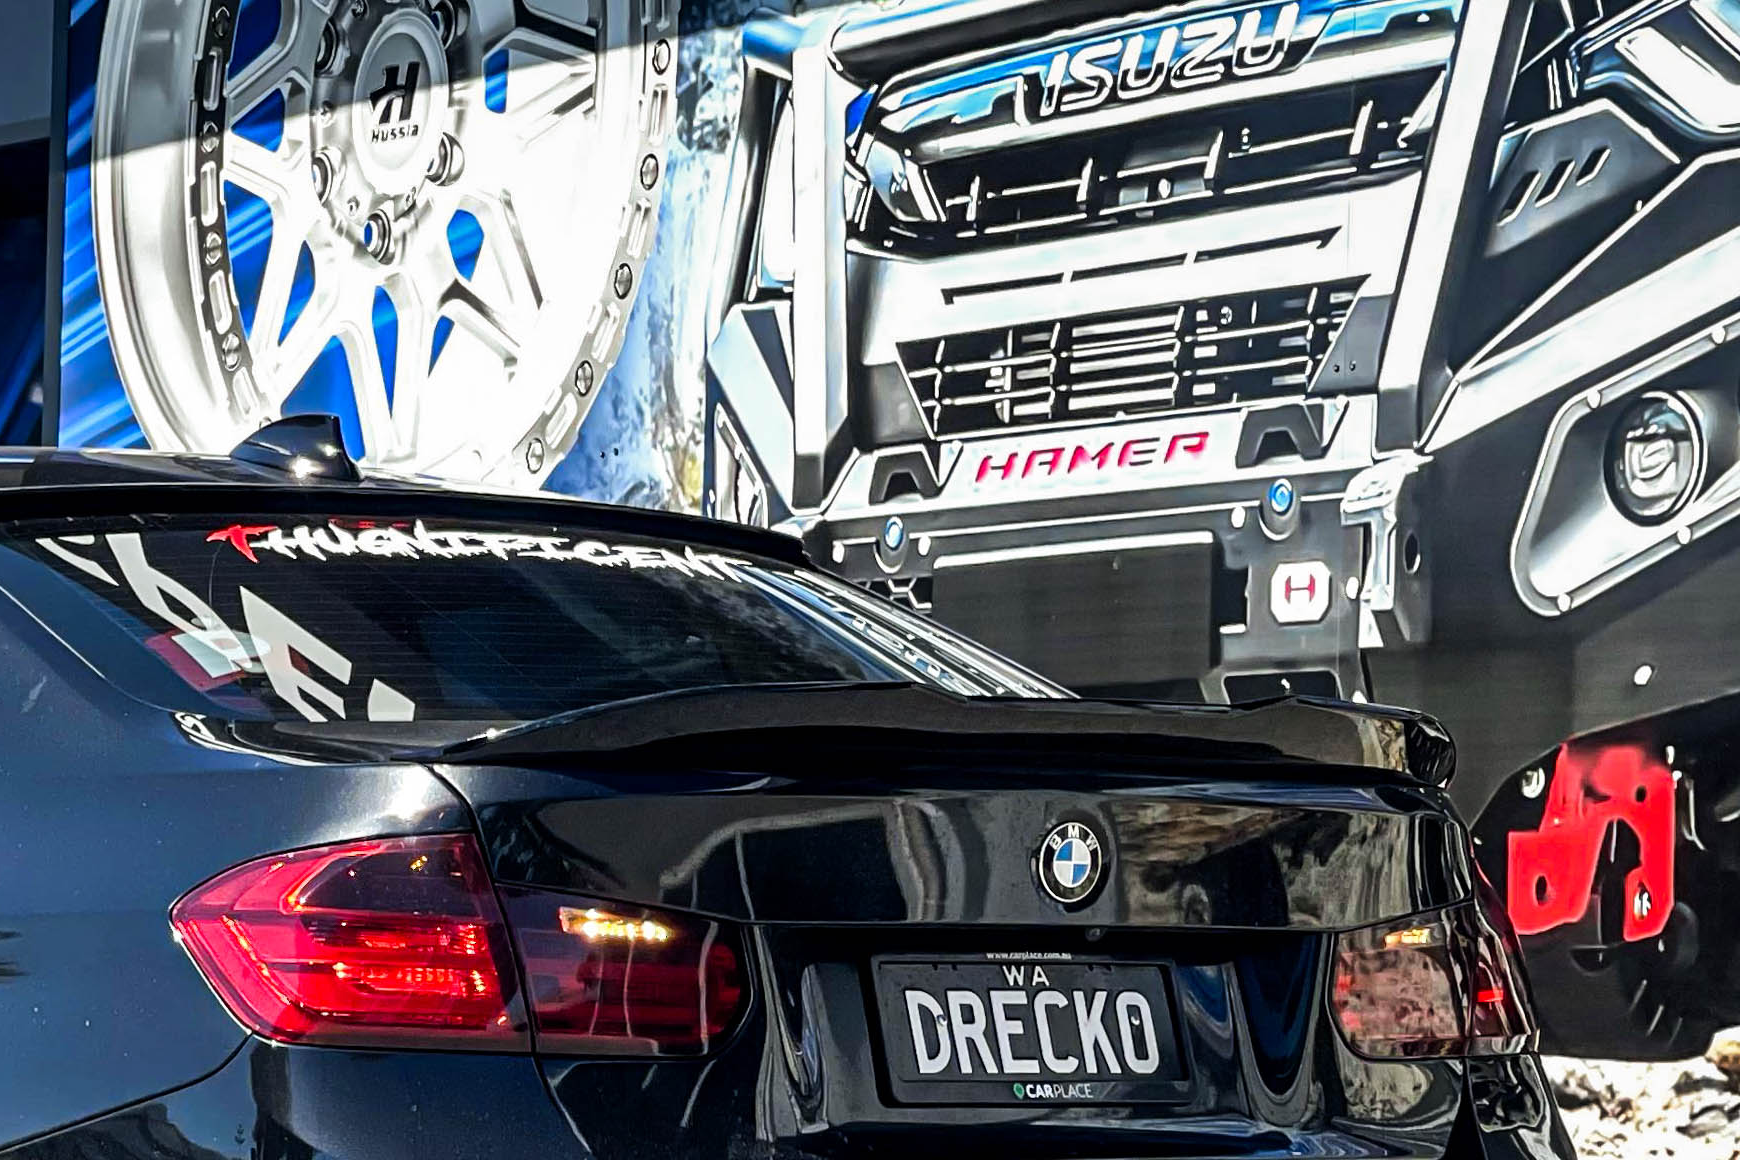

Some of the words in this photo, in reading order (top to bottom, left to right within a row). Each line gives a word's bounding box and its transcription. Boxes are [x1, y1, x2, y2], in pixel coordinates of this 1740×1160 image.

[1040, 2, 1300, 116] ISUZU
[975, 431, 1210, 482] HAMER
[1049, 824, 1098, 851] BMW
[905, 990, 1160, 1074] DRECKO
[1025, 1083, 1093, 1099] CARPLACE
